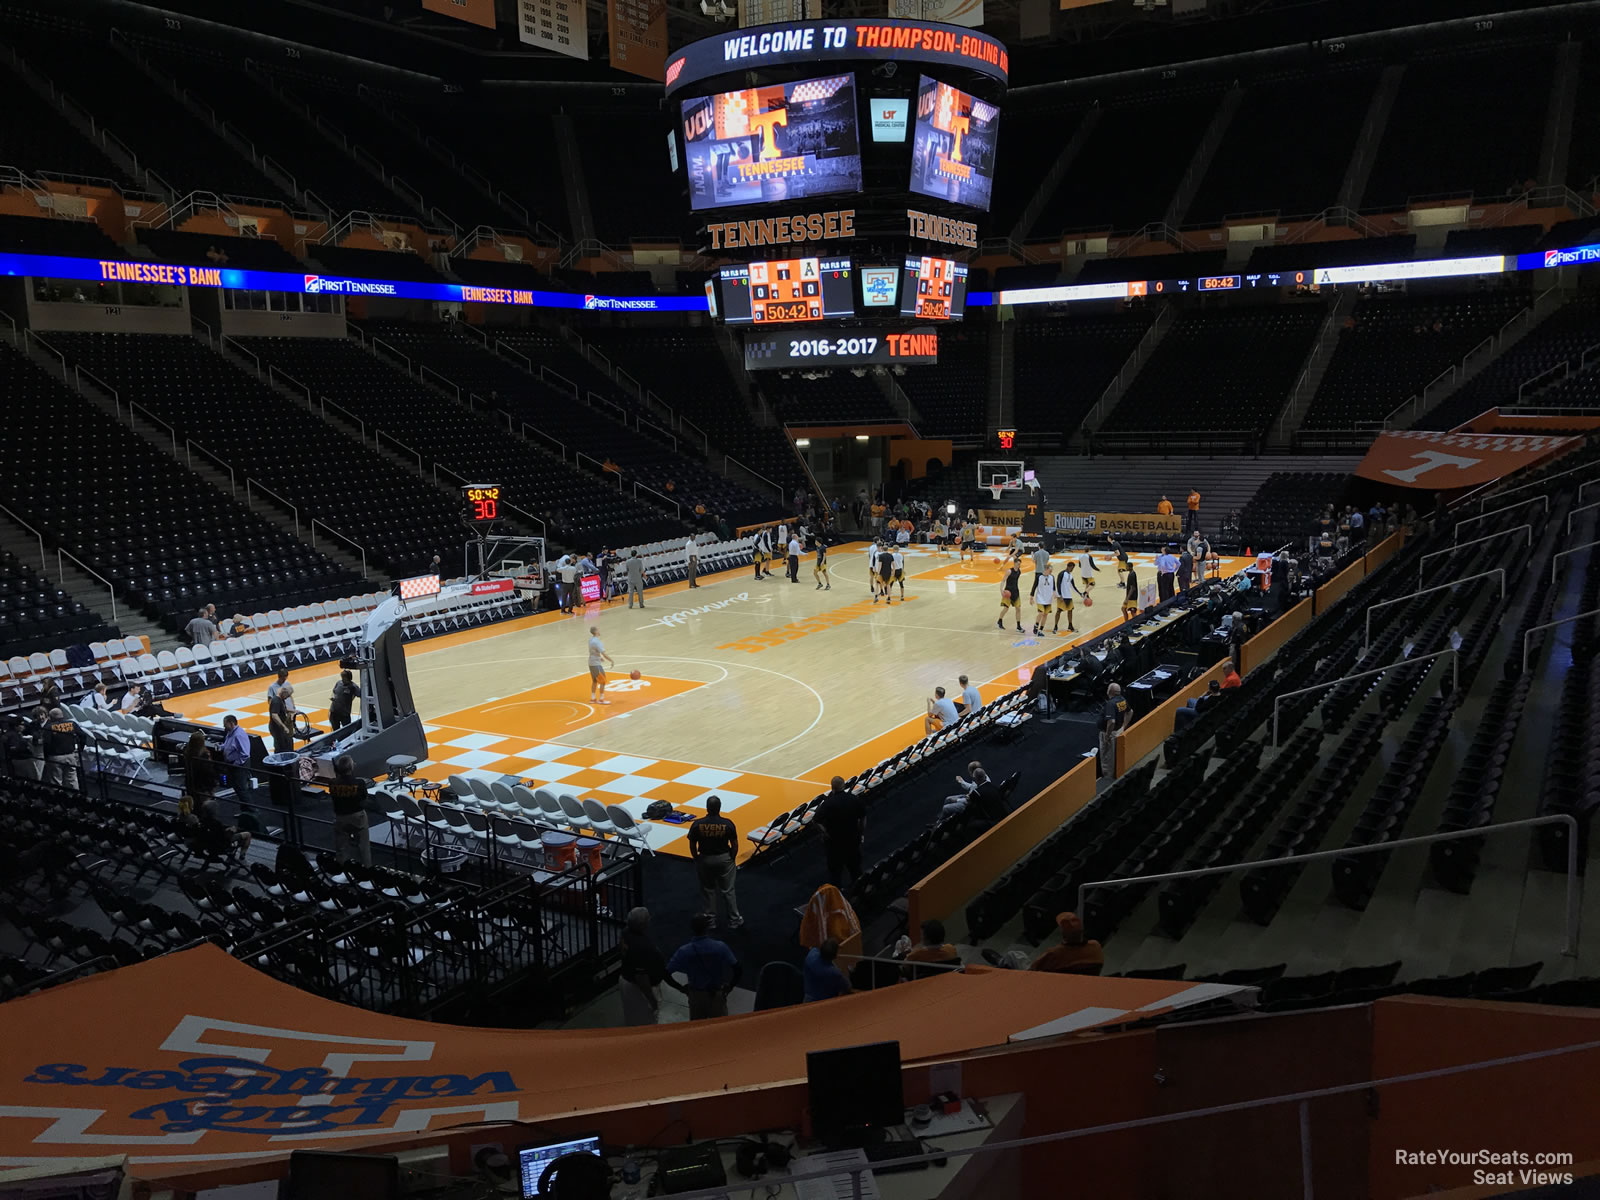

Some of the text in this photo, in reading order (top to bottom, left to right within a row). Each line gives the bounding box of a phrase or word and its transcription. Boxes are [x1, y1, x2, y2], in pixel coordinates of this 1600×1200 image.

[724, 29, 815, 61] WELCOME
[823, 27, 847, 48] TO
[856, 26, 998, 65] THOMPSON-BOLING
[285, 47, 301, 59] 324
[738, 157, 805, 177] TENNESSEE
[732, 168, 813, 183] BASKETBALL
[707, 209, 856, 250] TENNESSEE
[907, 209, 978, 249] TENNESSEE
[99, 261, 222, 286] TENNESSEE'S BANK
[781, 270, 787, 280] 1
[1295, 272, 1304, 284] 0
[807, 284, 814, 295] 0
[1155, 281, 1164, 293] 0
[1204, 278, 1234, 289] 50:42
[1251, 280, 1256, 288] 1
[461, 286, 533, 305] TENNESSEE'S BANK
[757, 288, 764, 298] 0
[772, 291, 778, 299] 4
[793, 289, 799, 297] 4
[768, 305, 806, 320] 50:42
[812, 309, 819, 317] 0
[923, 303, 943, 316] 50:42
[755, 312, 761, 320] 0
[789, 338, 878, 357] 2016-2017
[998, 431, 1015, 439] 50:42
[1000, 438, 1012, 449] 30
[467, 489, 499, 501] 50:42
[474, 500, 497, 520] 30
[1054, 513, 1097, 530] ROWDIES
[1100, 519, 1180, 531] BASKETBALL
[699, 823, 727, 831] EVENT
